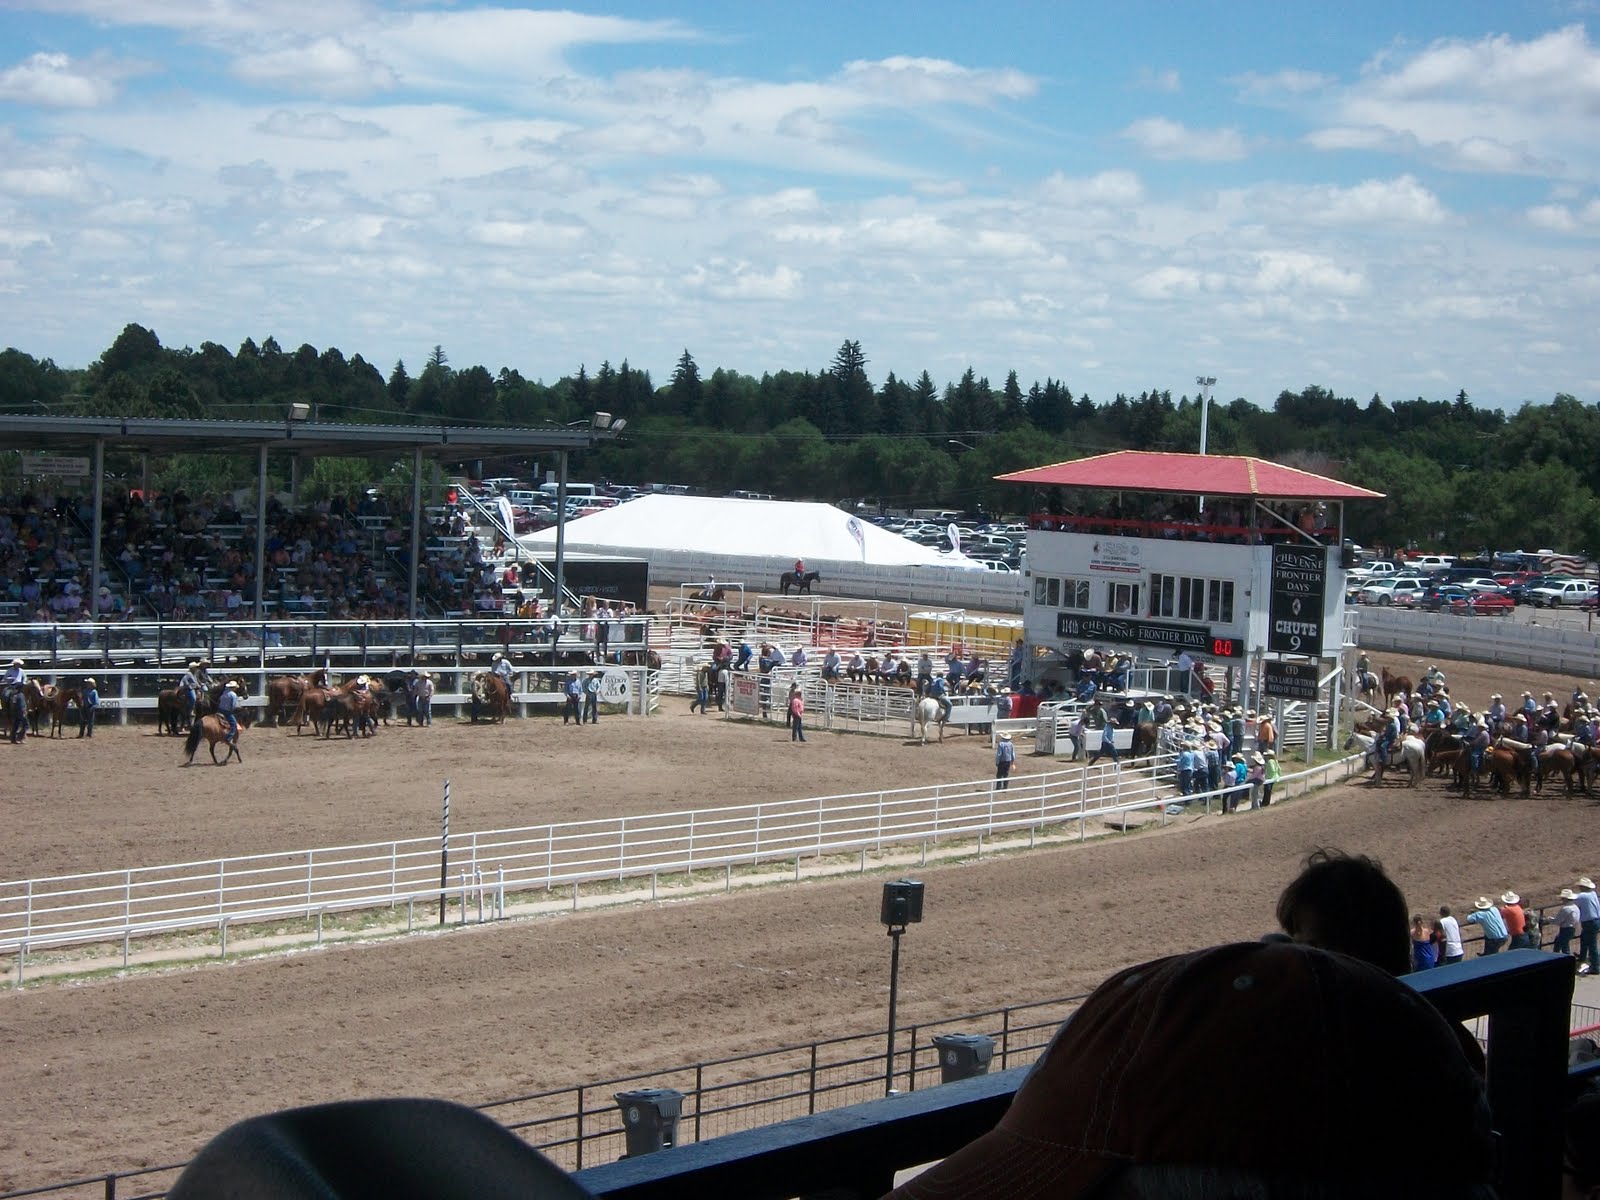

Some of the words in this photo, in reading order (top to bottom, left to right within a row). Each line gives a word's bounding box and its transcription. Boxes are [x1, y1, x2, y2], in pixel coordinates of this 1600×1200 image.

[1275, 554, 1323, 569] CHEYENNE
[1276, 570, 1321, 582] FRONTIER
[1287, 582, 1310, 591] DAYS
[1082, 621, 1135, 638] CHEYENNE
[1138, 628, 1180, 642] FRONTIER
[1184, 633, 1206, 645] DAYS
[1276, 620, 1317, 636] CHUTE
[1290, 636, 1301, 651] 9
[1285, 665, 1299, 675] CFD
